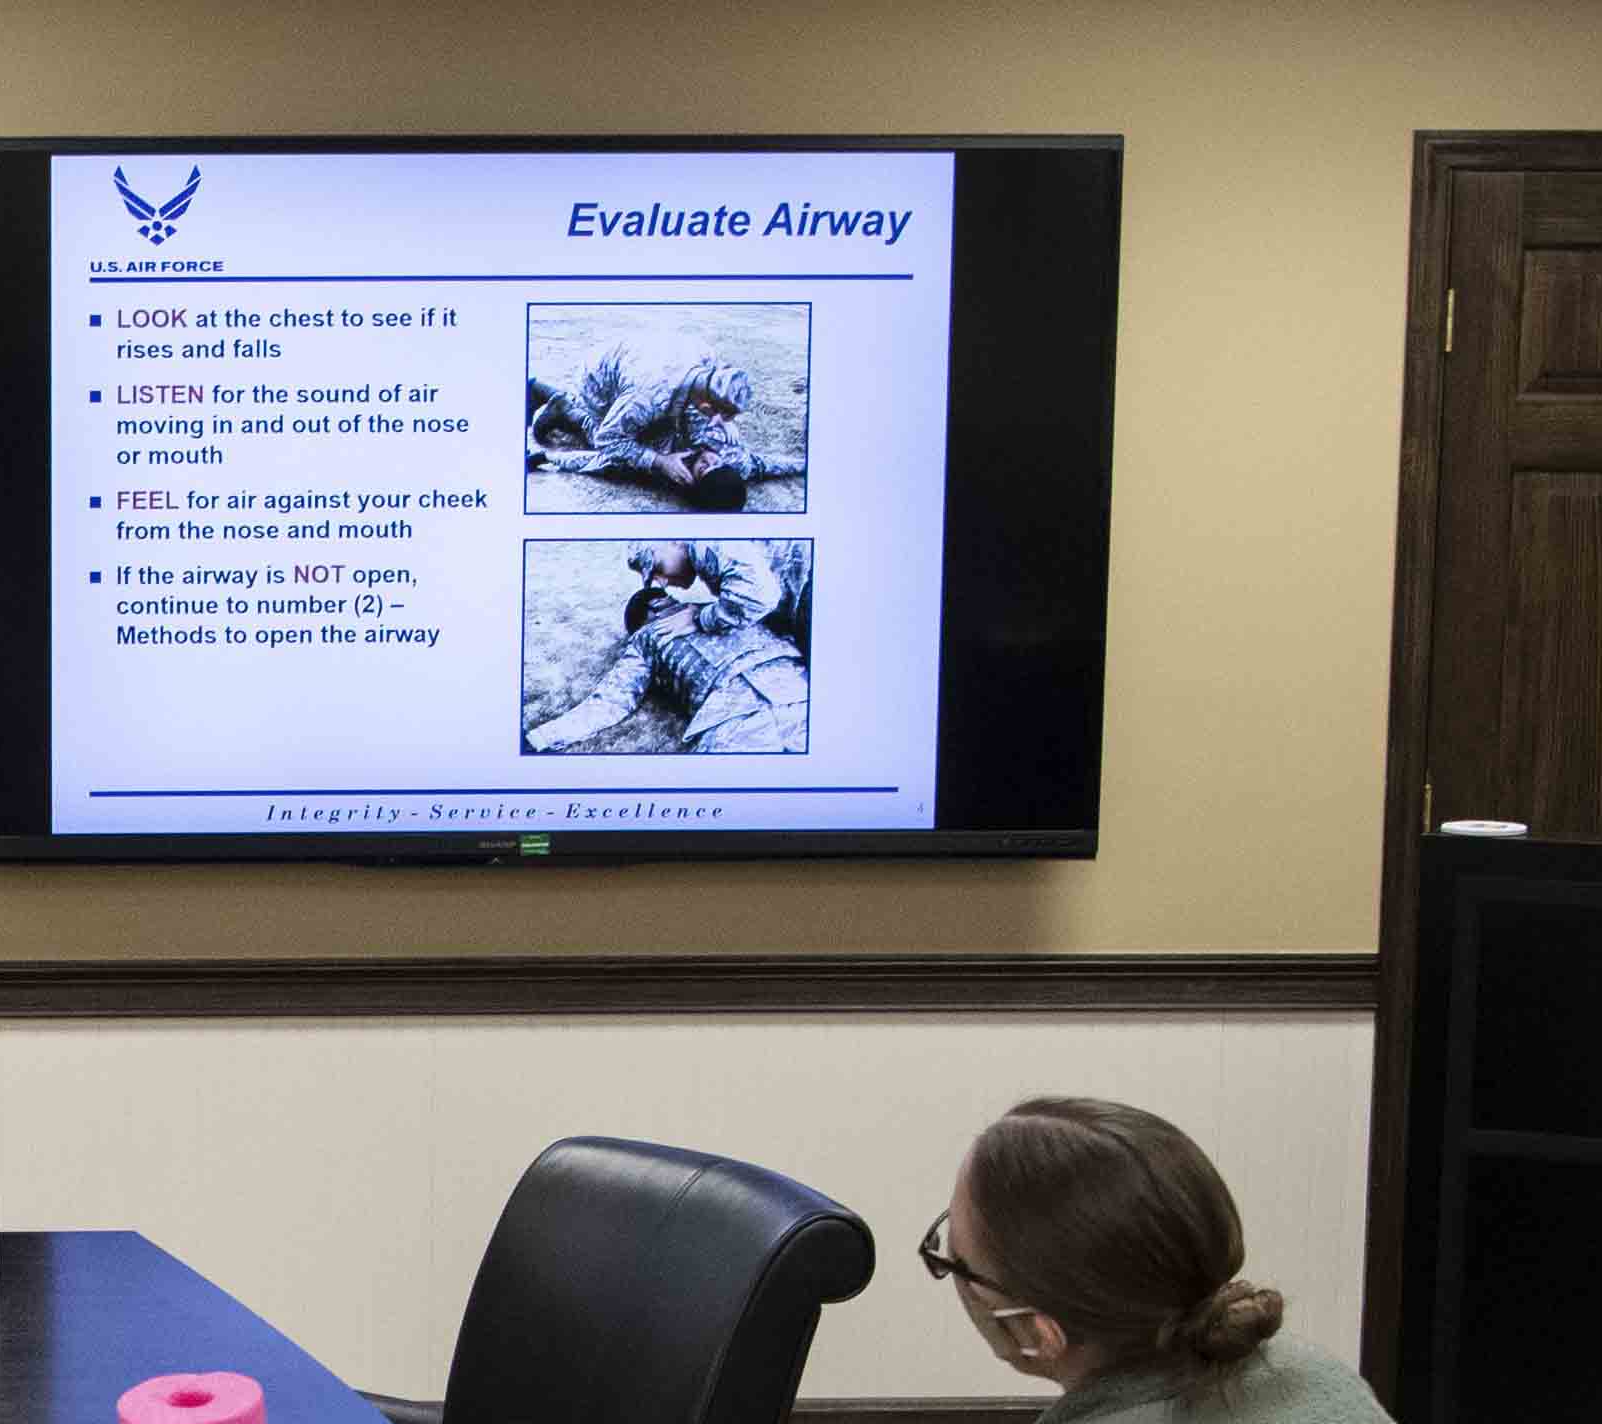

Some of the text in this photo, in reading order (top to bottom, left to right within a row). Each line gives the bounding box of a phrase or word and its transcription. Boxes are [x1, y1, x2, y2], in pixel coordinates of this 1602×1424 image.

[567, 202, 913, 246] Evaluate Airway
[90, 260, 224, 273] U.S. AIR FORCE
[117, 307, 457, 329] LOOK at the chest to see if it
[117, 338, 282, 359] rises and falls
[117, 383, 439, 405] LISTEN for the sound of air
[117, 413, 469, 439] moving in and out of the nose
[116, 445, 223, 465] or mouth
[117, 488, 487, 514] FEEL for air against your cheek
[116, 519, 412, 540] from the nose and mouth
[117, 564, 417, 589] If the airway is NOT open,
[116, 595, 218, 615] continue
[226, 596, 249, 614] to
[257, 594, 348, 615] number
[354, 594, 383, 619] (2)
[116, 624, 441, 649] Methods to open the airway
[267, 804, 401, 825] Integrity
[428, 803, 536, 820] Service
[565, 802, 723, 819] Excellence
